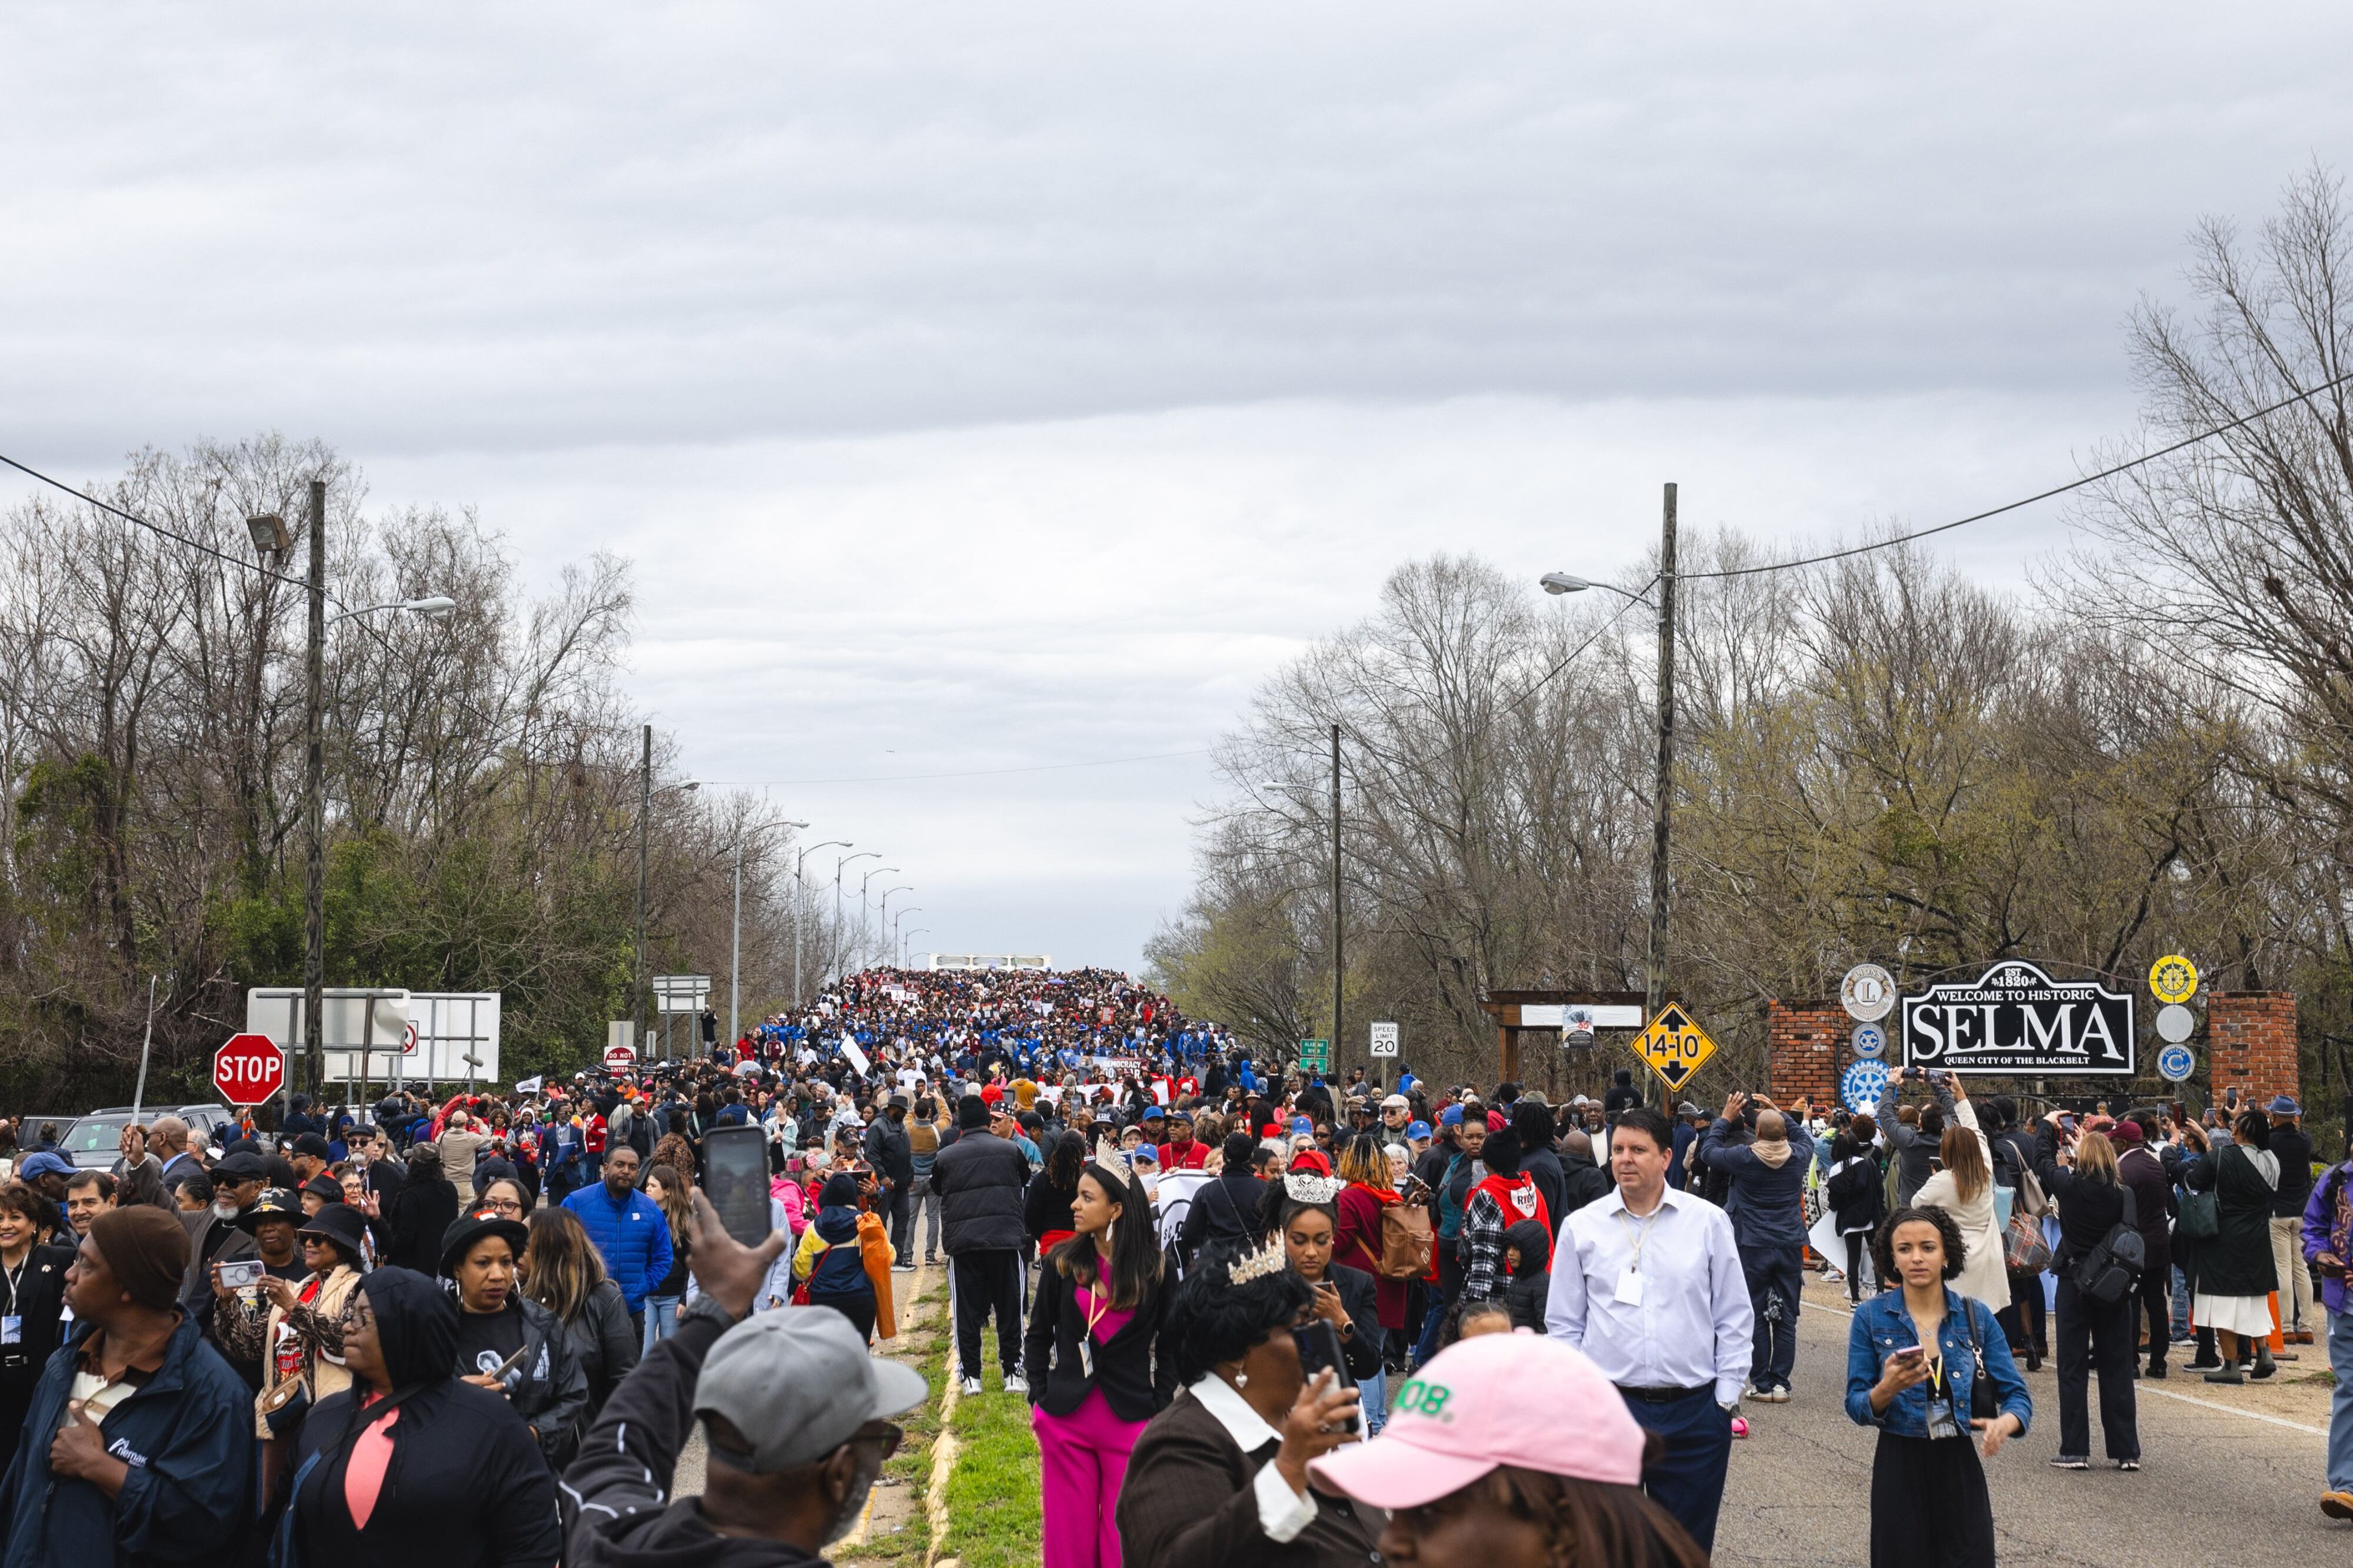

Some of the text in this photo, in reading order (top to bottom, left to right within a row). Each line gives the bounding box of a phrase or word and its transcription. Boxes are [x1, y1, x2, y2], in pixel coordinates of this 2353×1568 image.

[1854, 968, 1881, 978] LIONS
[2005, 968, 2022, 976] EST
[1999, 976, 2029, 987] 1820
[1861, 982, 1876, 1002] L
[1937, 989, 2095, 1002] WELCOME TO HISTORIC
[1911, 1002, 2124, 1060] SELMA
[1374, 1040, 1395, 1052] 20
[1103, 1060, 1141, 1069] DEMOCRACY
[1944, 1056, 1975, 1065] QUEEN
[2036, 1056, 2090, 1065] BLACKBELT
[219, 1056, 280, 1082] STOP
